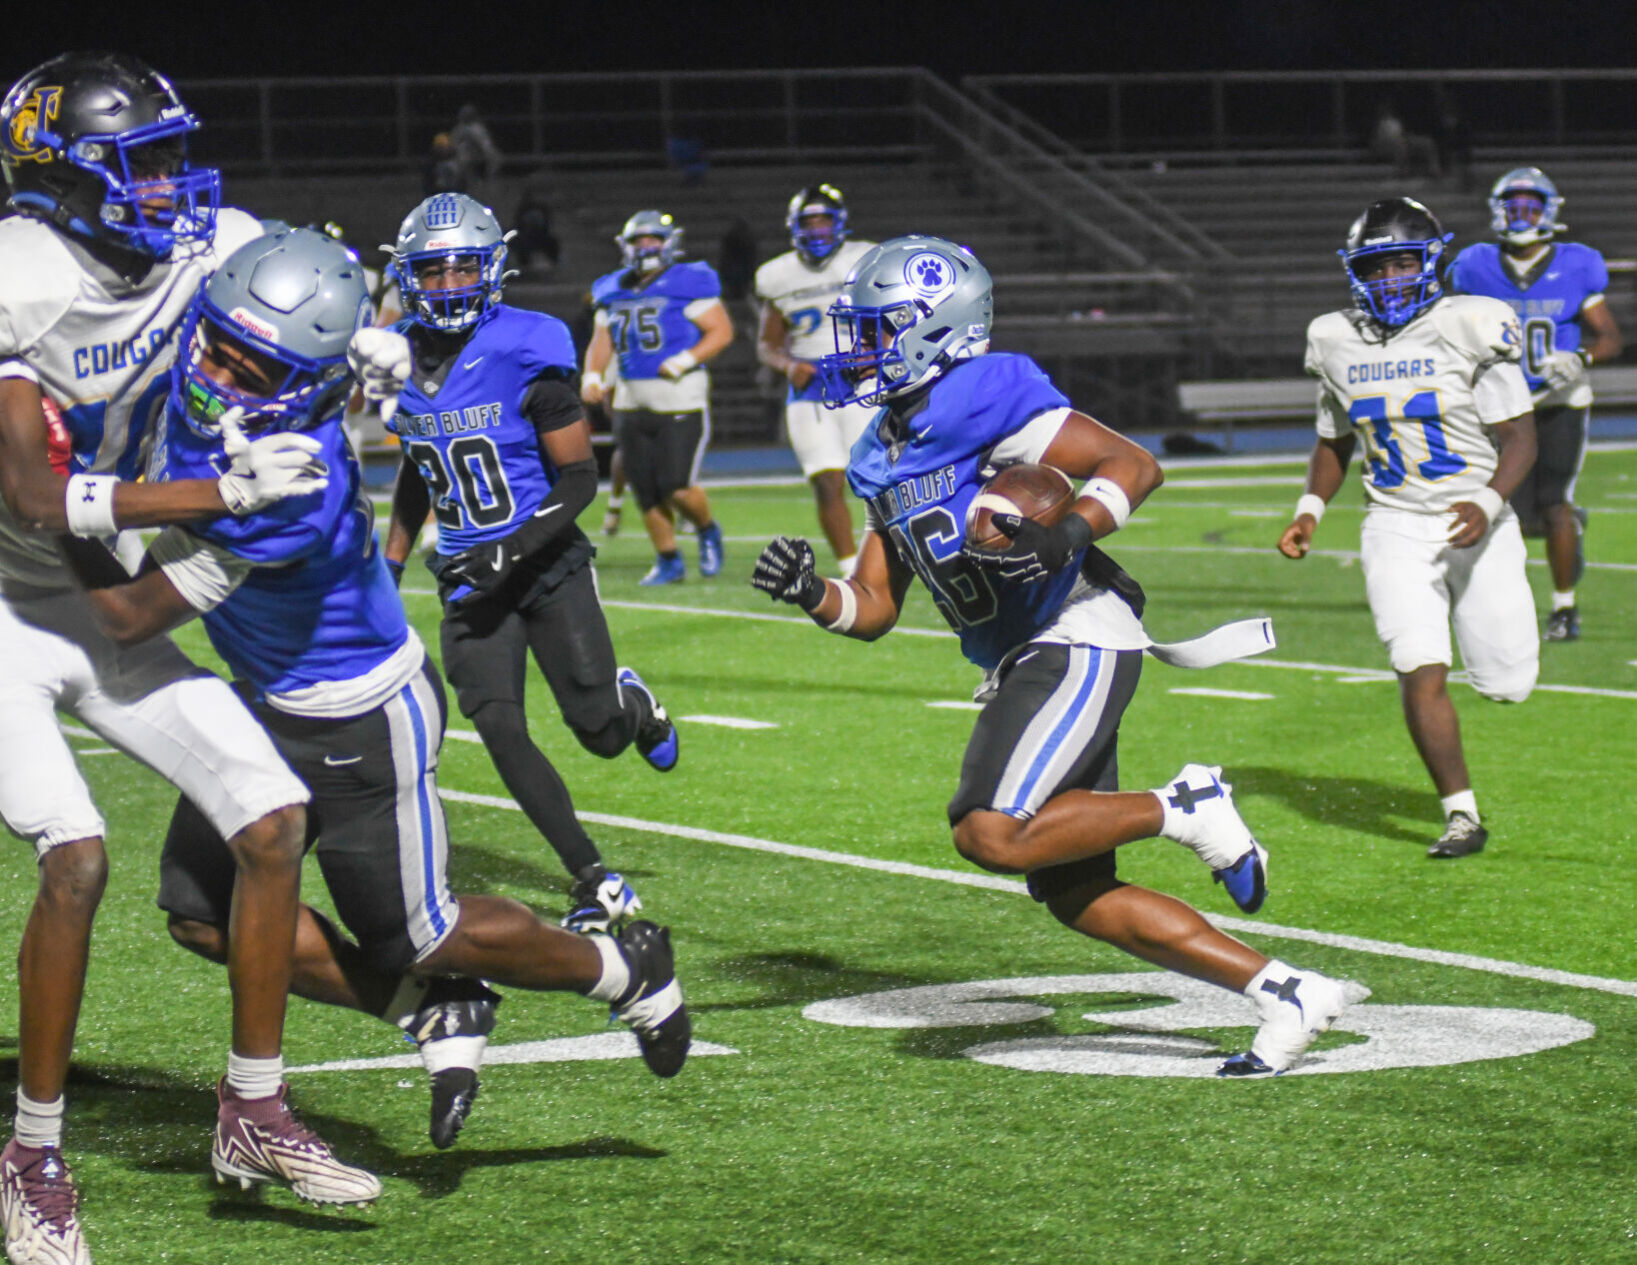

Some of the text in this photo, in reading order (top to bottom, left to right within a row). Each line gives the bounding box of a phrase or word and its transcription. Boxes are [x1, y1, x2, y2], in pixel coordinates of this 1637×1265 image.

[73, 327, 176, 380] COUGA
[607, 305, 665, 354] 75
[1348, 358, 1435, 384] COUGARS
[440, 401, 503, 436] BLUFF
[407, 433, 517, 530] 20
[899, 463, 957, 512] BLUFF
